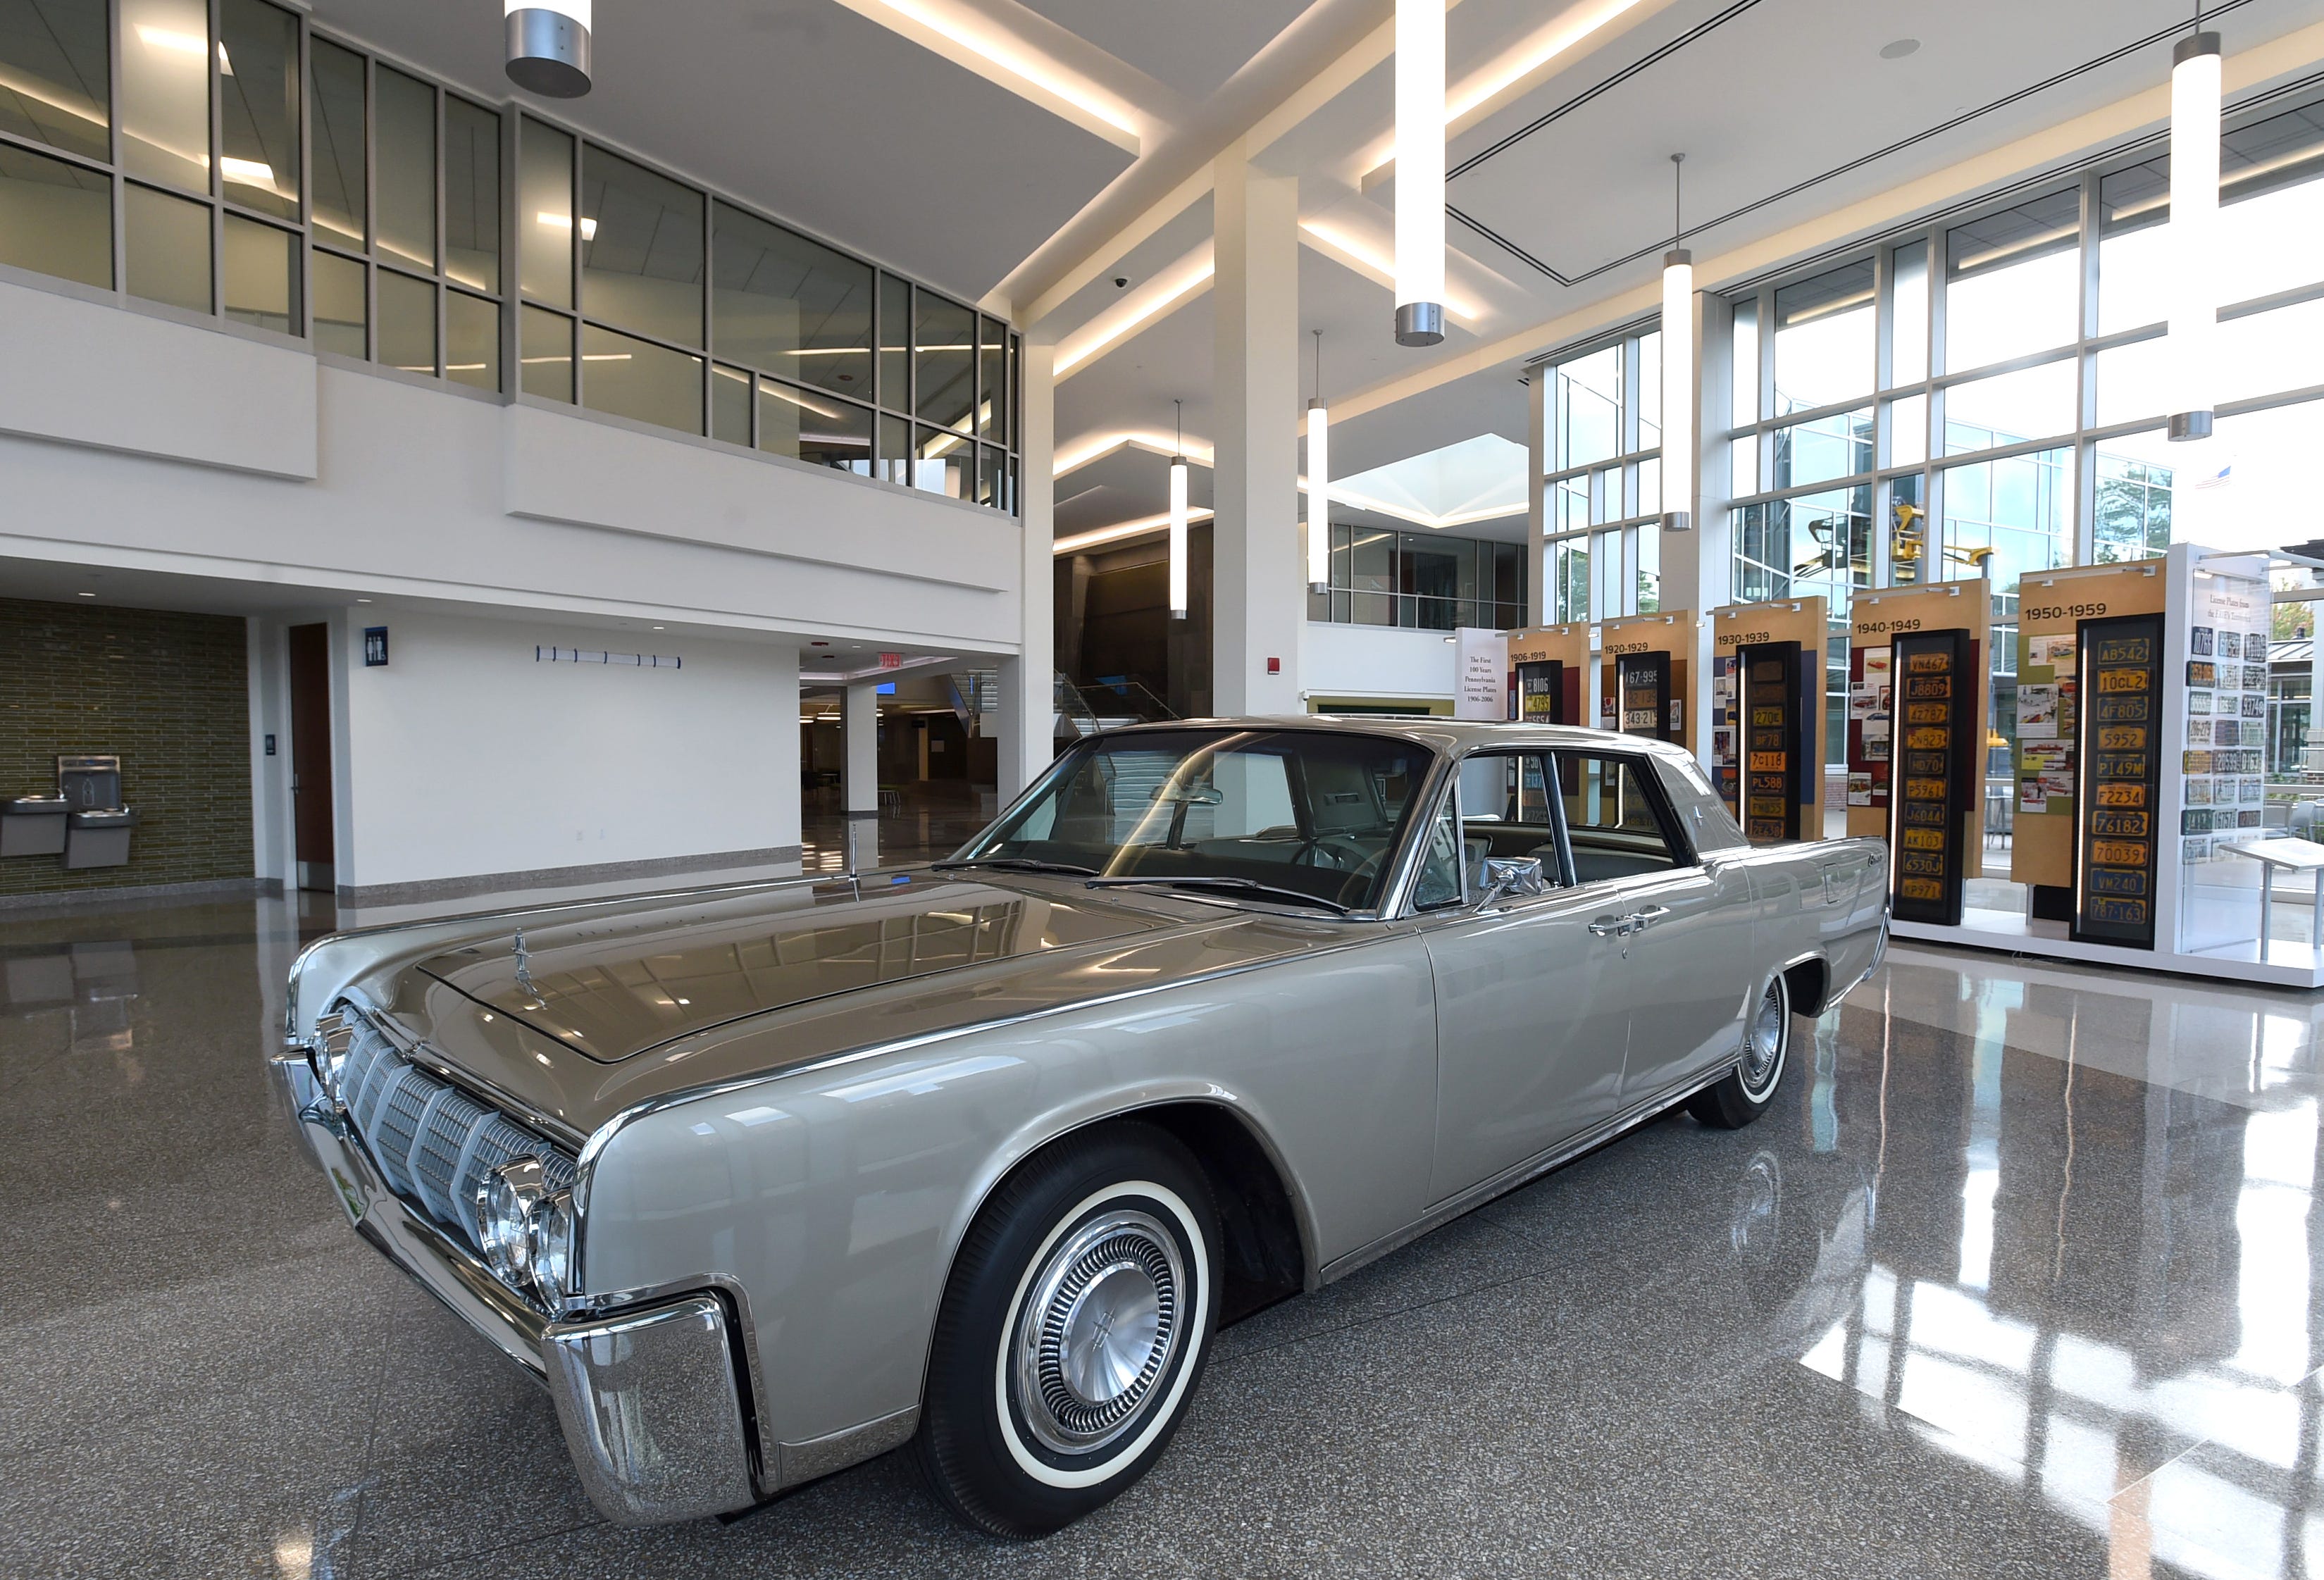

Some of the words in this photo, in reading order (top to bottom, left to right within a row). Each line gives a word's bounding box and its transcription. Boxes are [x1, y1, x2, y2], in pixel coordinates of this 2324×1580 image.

[2025, 602, 2106, 621] 1950-1959
[1856, 618, 1921, 634] 1940-1949
[1718, 631, 1770, 645] 1930-1939
[1605, 642, 1648, 654] 1920-1929
[1510, 651, 1546, 662] 1906-1919
[1533, 677, 1548, 693] 8106
[1911, 683, 1946, 696] J8809
[1533, 696, 1549, 711] 4795
[1756, 711, 1780, 724] 270E
[2105, 733, 2138, 747] 5952
[2097, 819, 2142, 833] 76182
[2097, 847, 2140, 861] 70039
